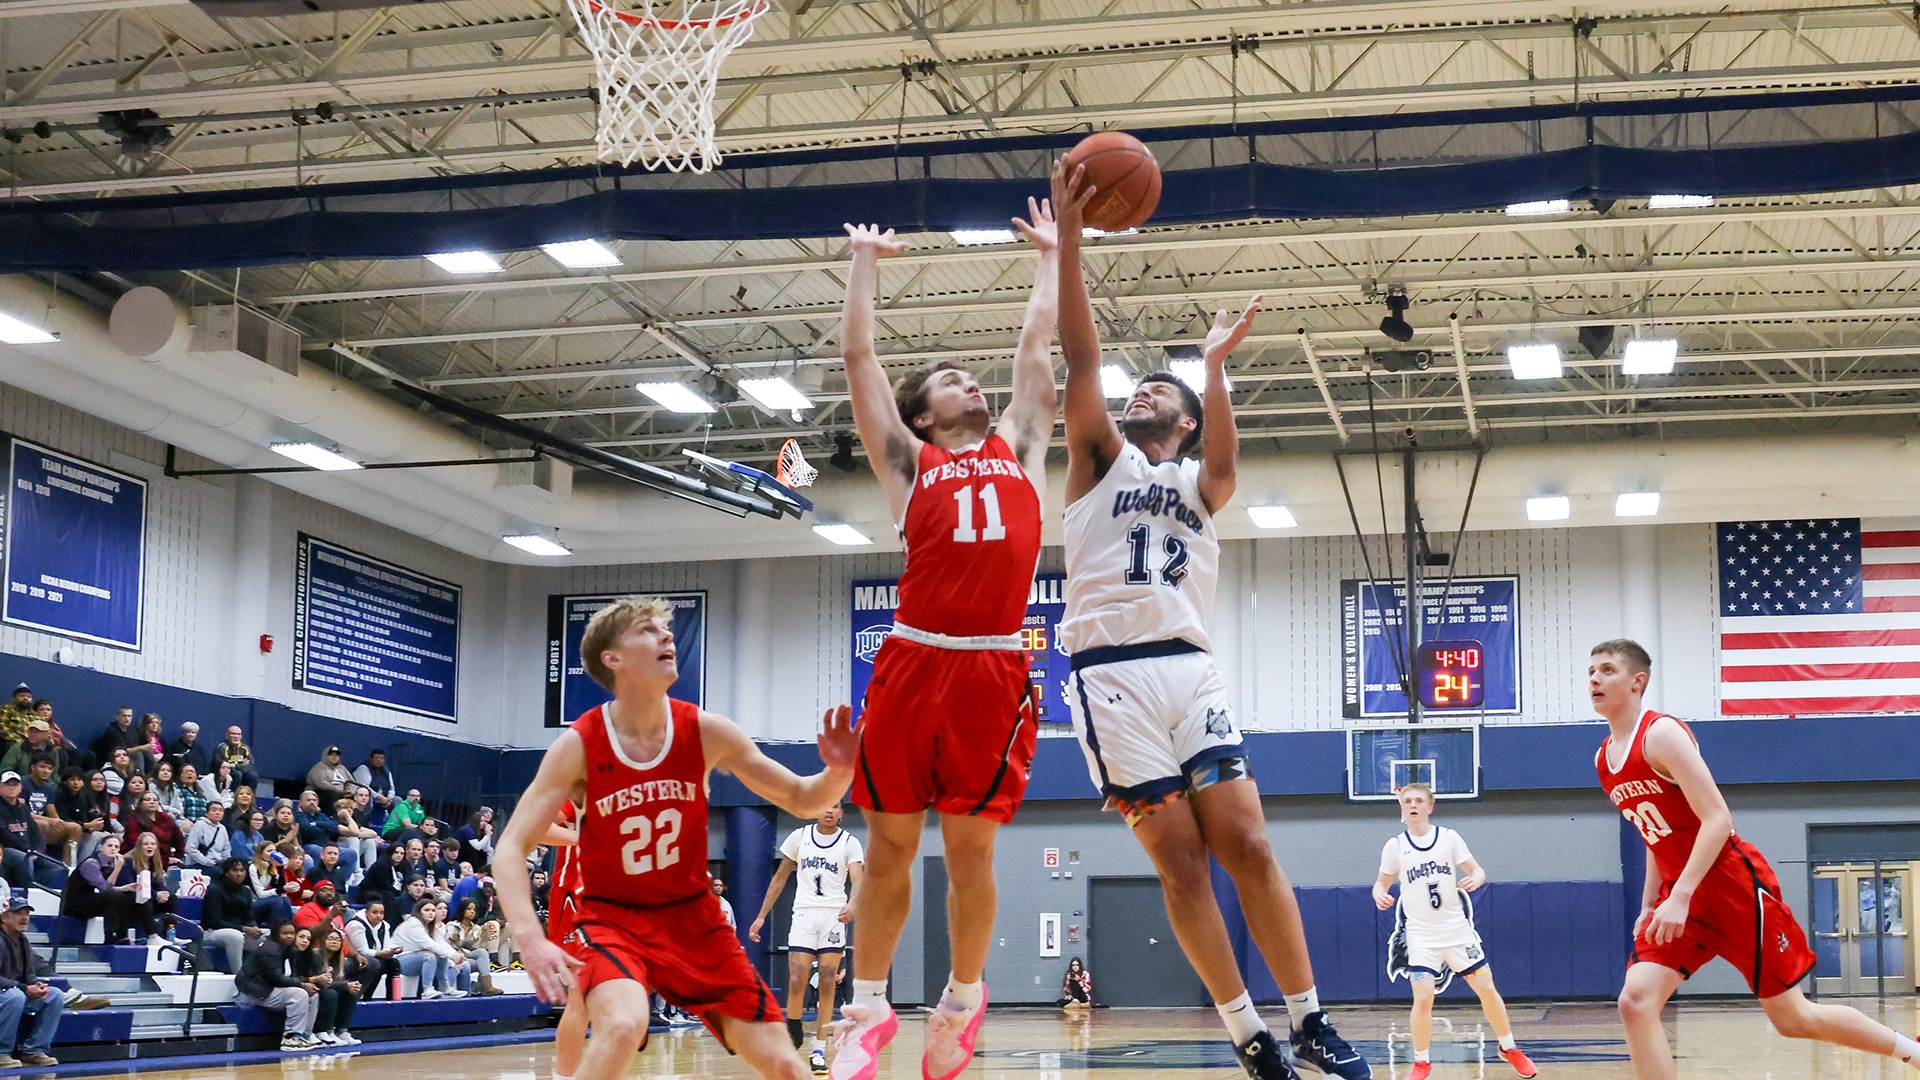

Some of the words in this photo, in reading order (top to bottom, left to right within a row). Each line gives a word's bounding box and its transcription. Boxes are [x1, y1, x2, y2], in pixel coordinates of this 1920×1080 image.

[921, 457, 1023, 489] WESTERN
[953, 482, 1006, 543] 11
[1125, 523, 1190, 591] 12
[296, 541, 307, 638] CHAMPIONSHIPS
[1022, 615, 1046, 625] uests
[1345, 595, 1356, 653] VOLLEYBALL
[1020, 628, 1047, 650] 36
[549, 640, 560, 683] ESPORTS
[567, 667, 584, 675] 2022
[1028, 669, 1045, 679] ouls
[1436, 649, 1479, 668] 4:40
[1345, 656, 1357, 704] WOMEN'S
[1434, 674, 1468, 702] 24
[596, 779, 696, 817] WESTERN
[620, 807, 682, 875] 22
[1622, 801, 1673, 846] 20
[813, 873, 826, 897] 1
[1426, 881, 1442, 911] 5
